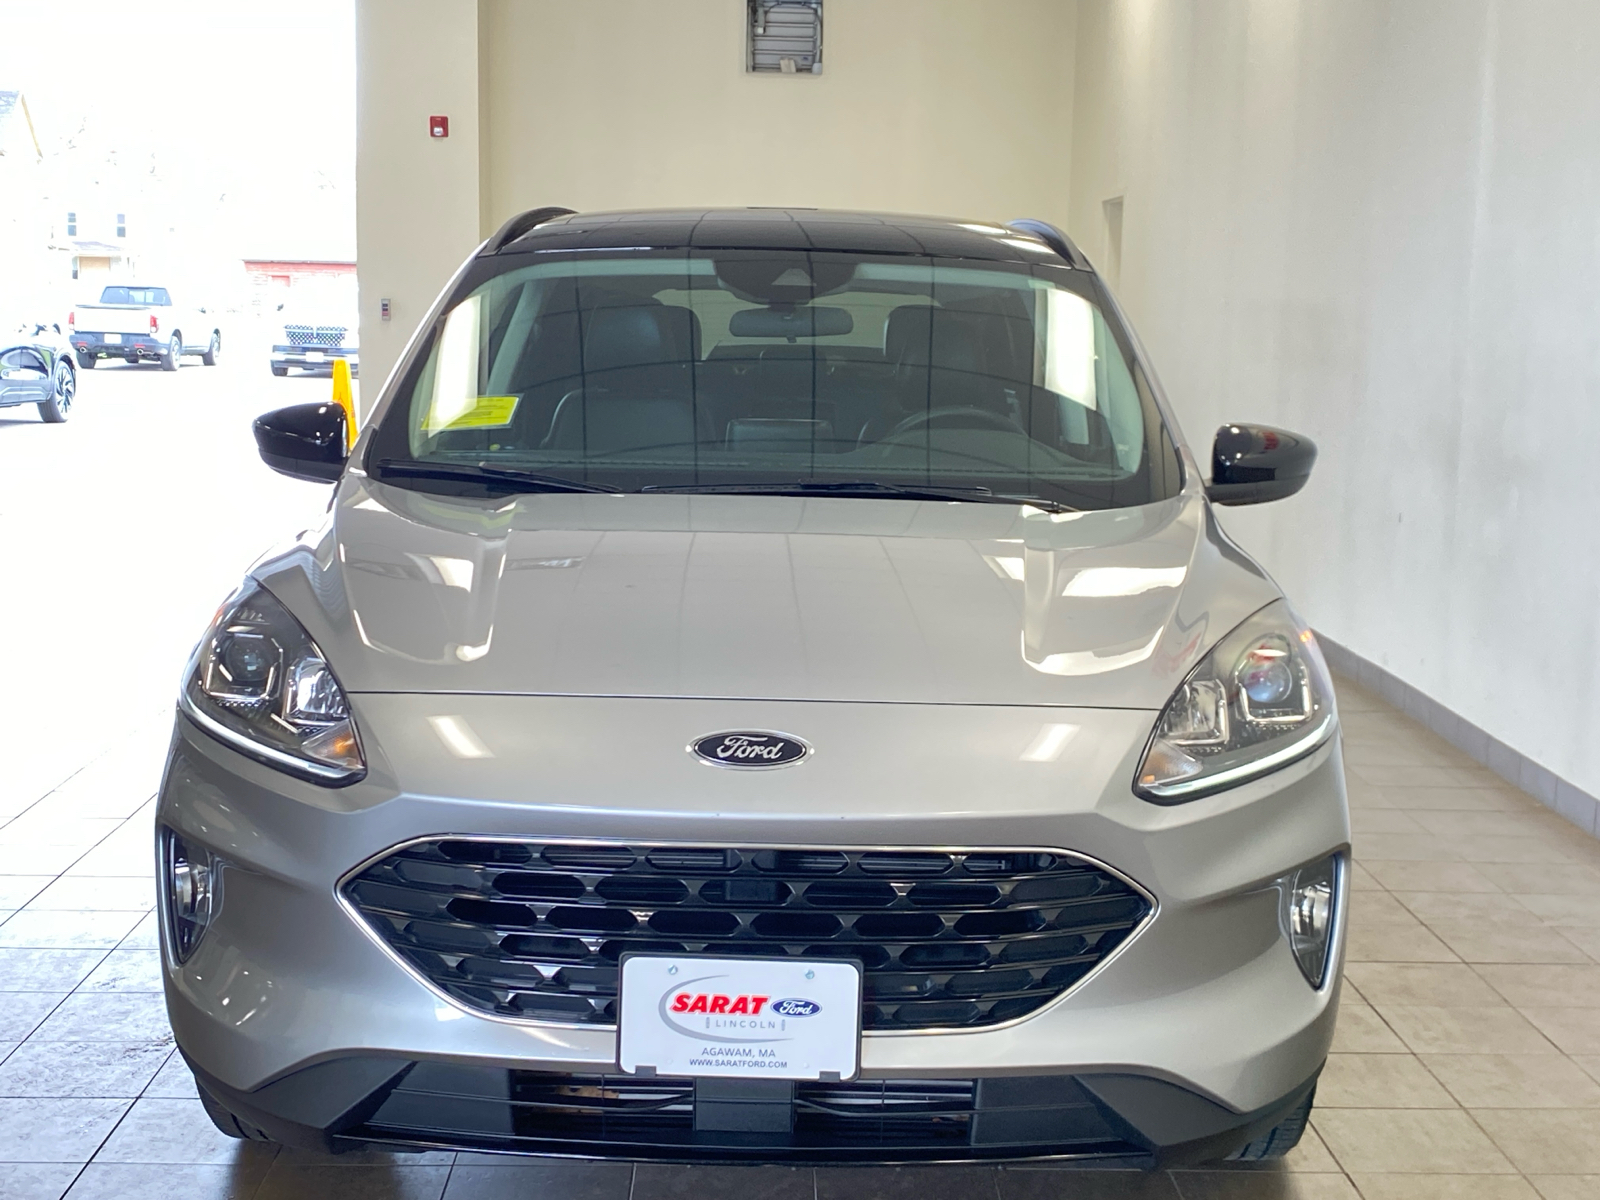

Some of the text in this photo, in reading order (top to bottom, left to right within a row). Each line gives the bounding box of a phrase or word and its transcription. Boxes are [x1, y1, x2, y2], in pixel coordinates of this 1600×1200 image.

[716, 735, 784, 759] Ford
[669, 992, 813, 1016] SARAT Ford
[715, 1019, 776, 1029] LINCOLN
[701, 1047, 776, 1058] AGAWAM, MA
[689, 1058, 788, 1069] WWW.SARATFORD.COM
